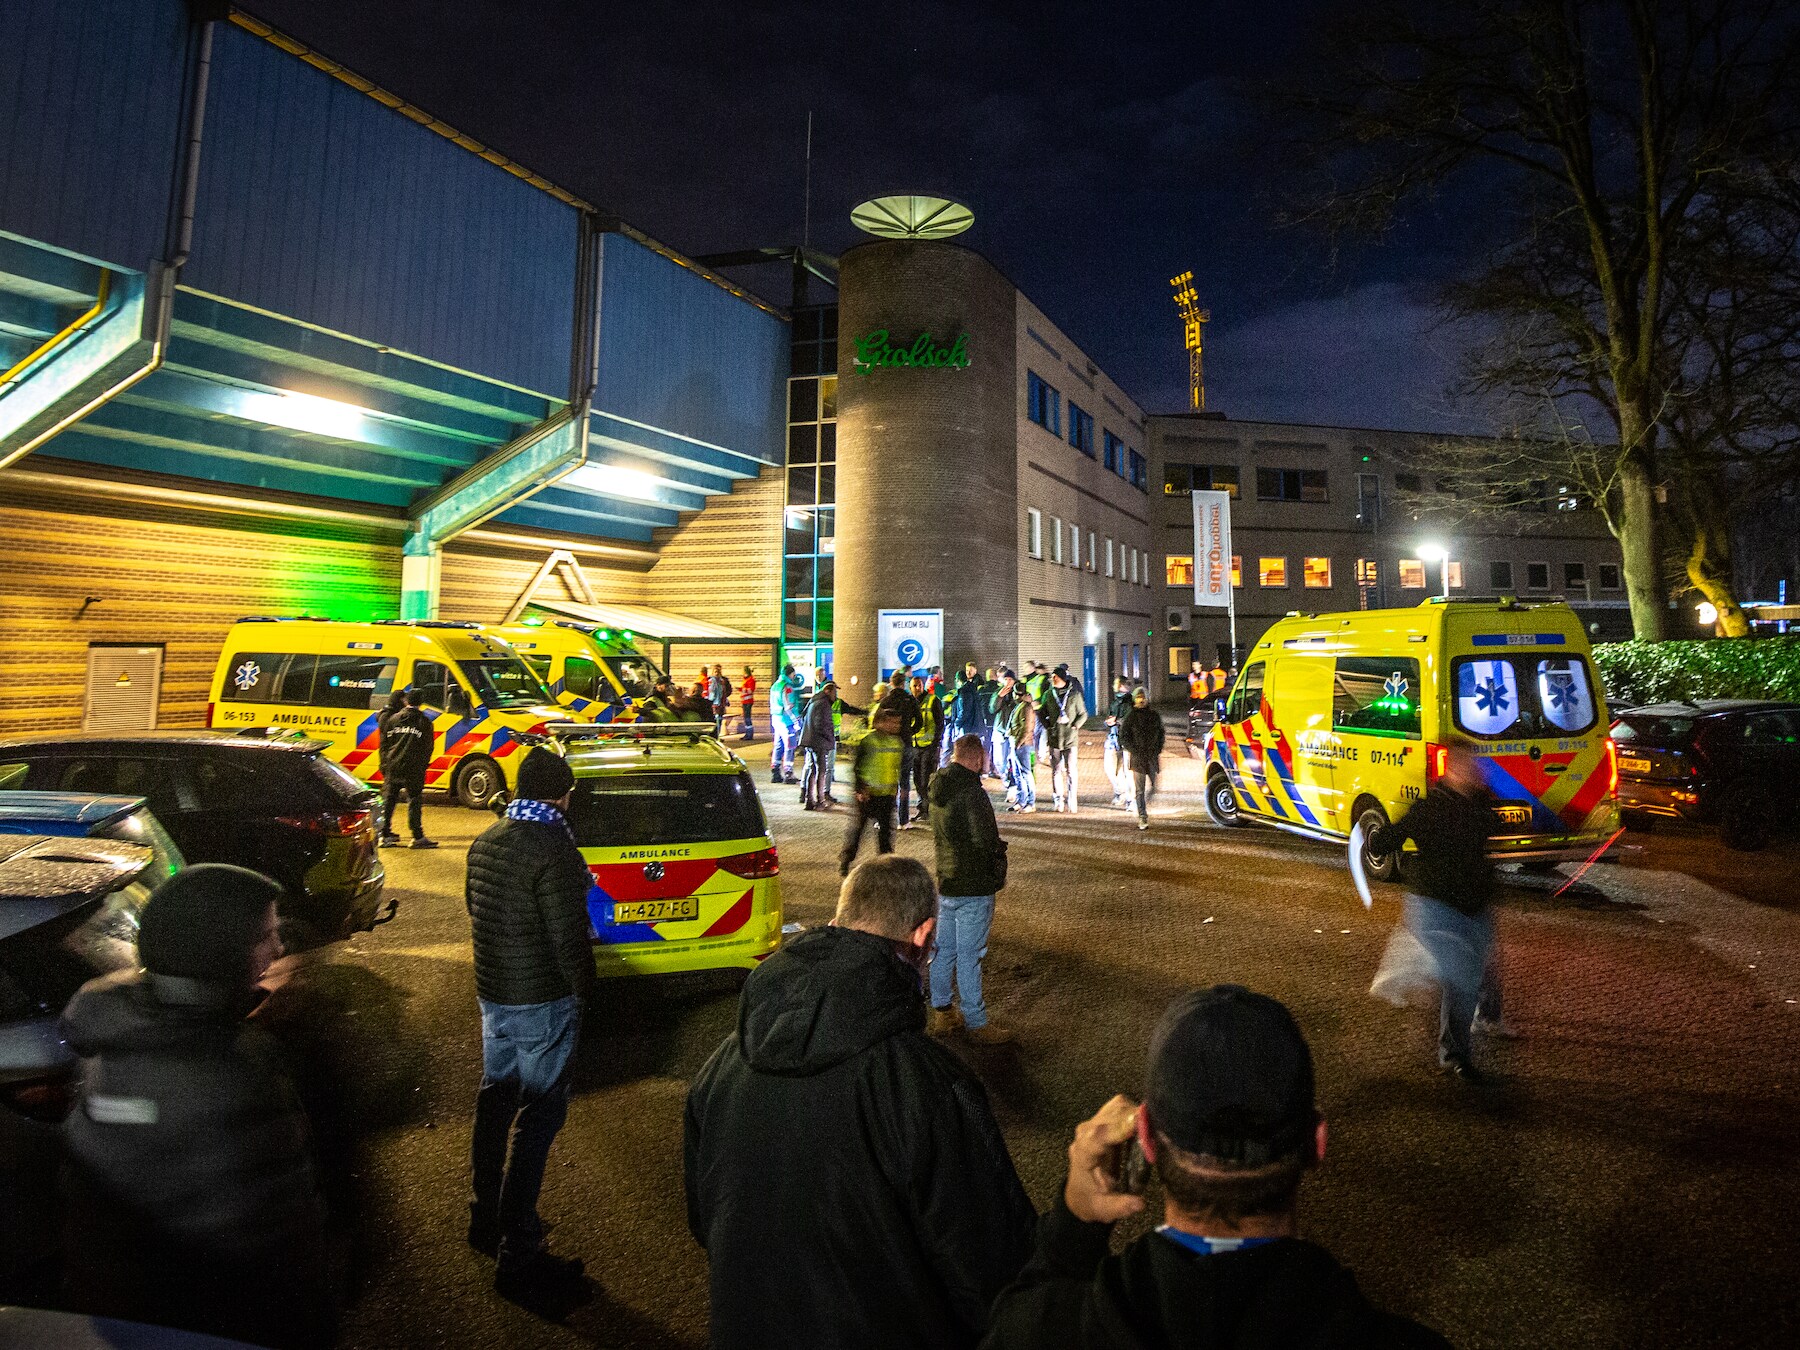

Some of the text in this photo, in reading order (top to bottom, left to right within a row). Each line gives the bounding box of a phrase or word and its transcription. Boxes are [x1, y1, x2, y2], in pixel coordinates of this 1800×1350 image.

[853, 328, 971, 376] Grolsch
[892, 621, 918, 629] WELKOM
[223, 711, 256, 722] 06-153
[271, 713, 347, 726] AMBULANCE
[1299, 742, 1359, 761] AMBULANCE
[1472, 742, 1527, 753] BULANCE
[1370, 750, 1405, 767] 07-114
[619, 848, 691, 859] AMBULANCE
[619, 901, 691, 919] H-427-FG
